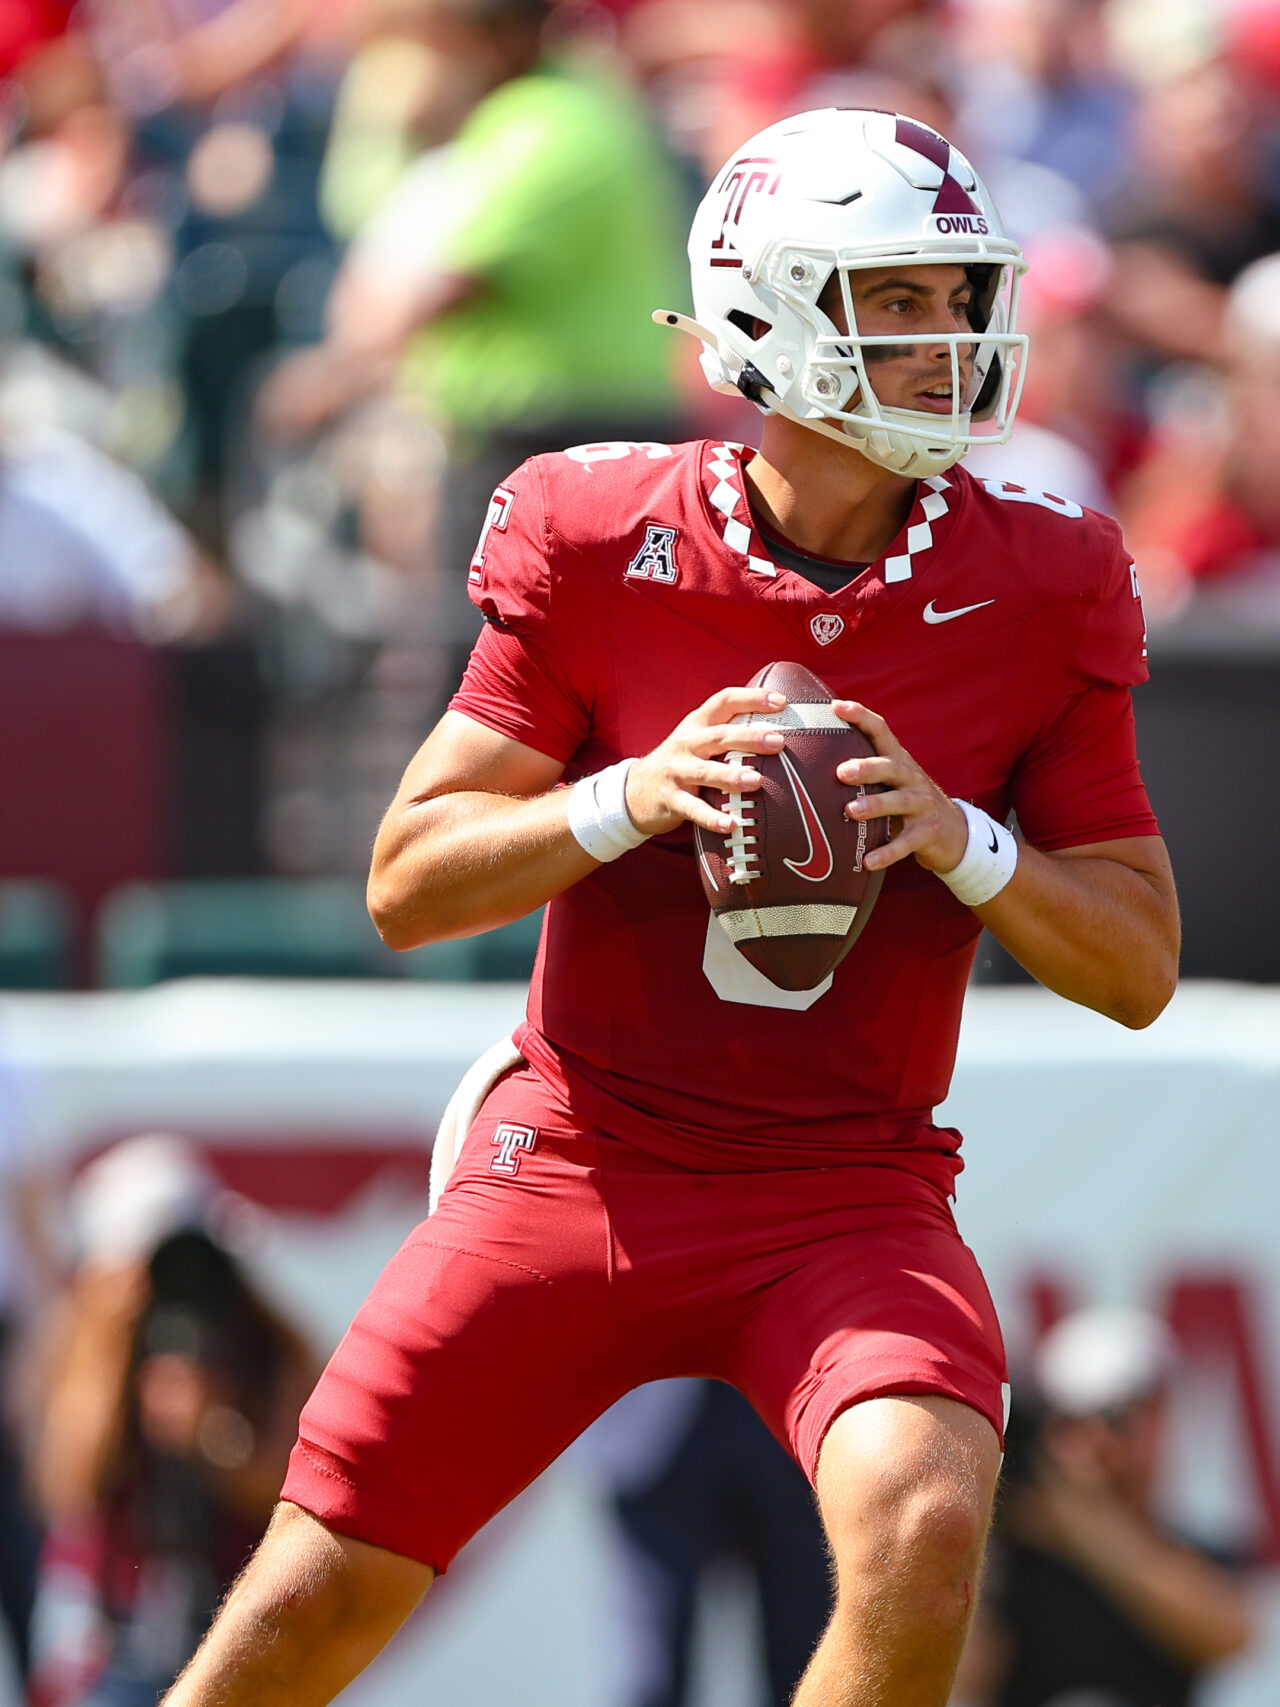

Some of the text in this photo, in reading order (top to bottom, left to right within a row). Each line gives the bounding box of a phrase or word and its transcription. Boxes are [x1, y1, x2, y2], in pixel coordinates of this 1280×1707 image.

[935, 216, 989, 235] OWLS
[625, 523, 679, 584] A
[491, 1122, 536, 1173] T
